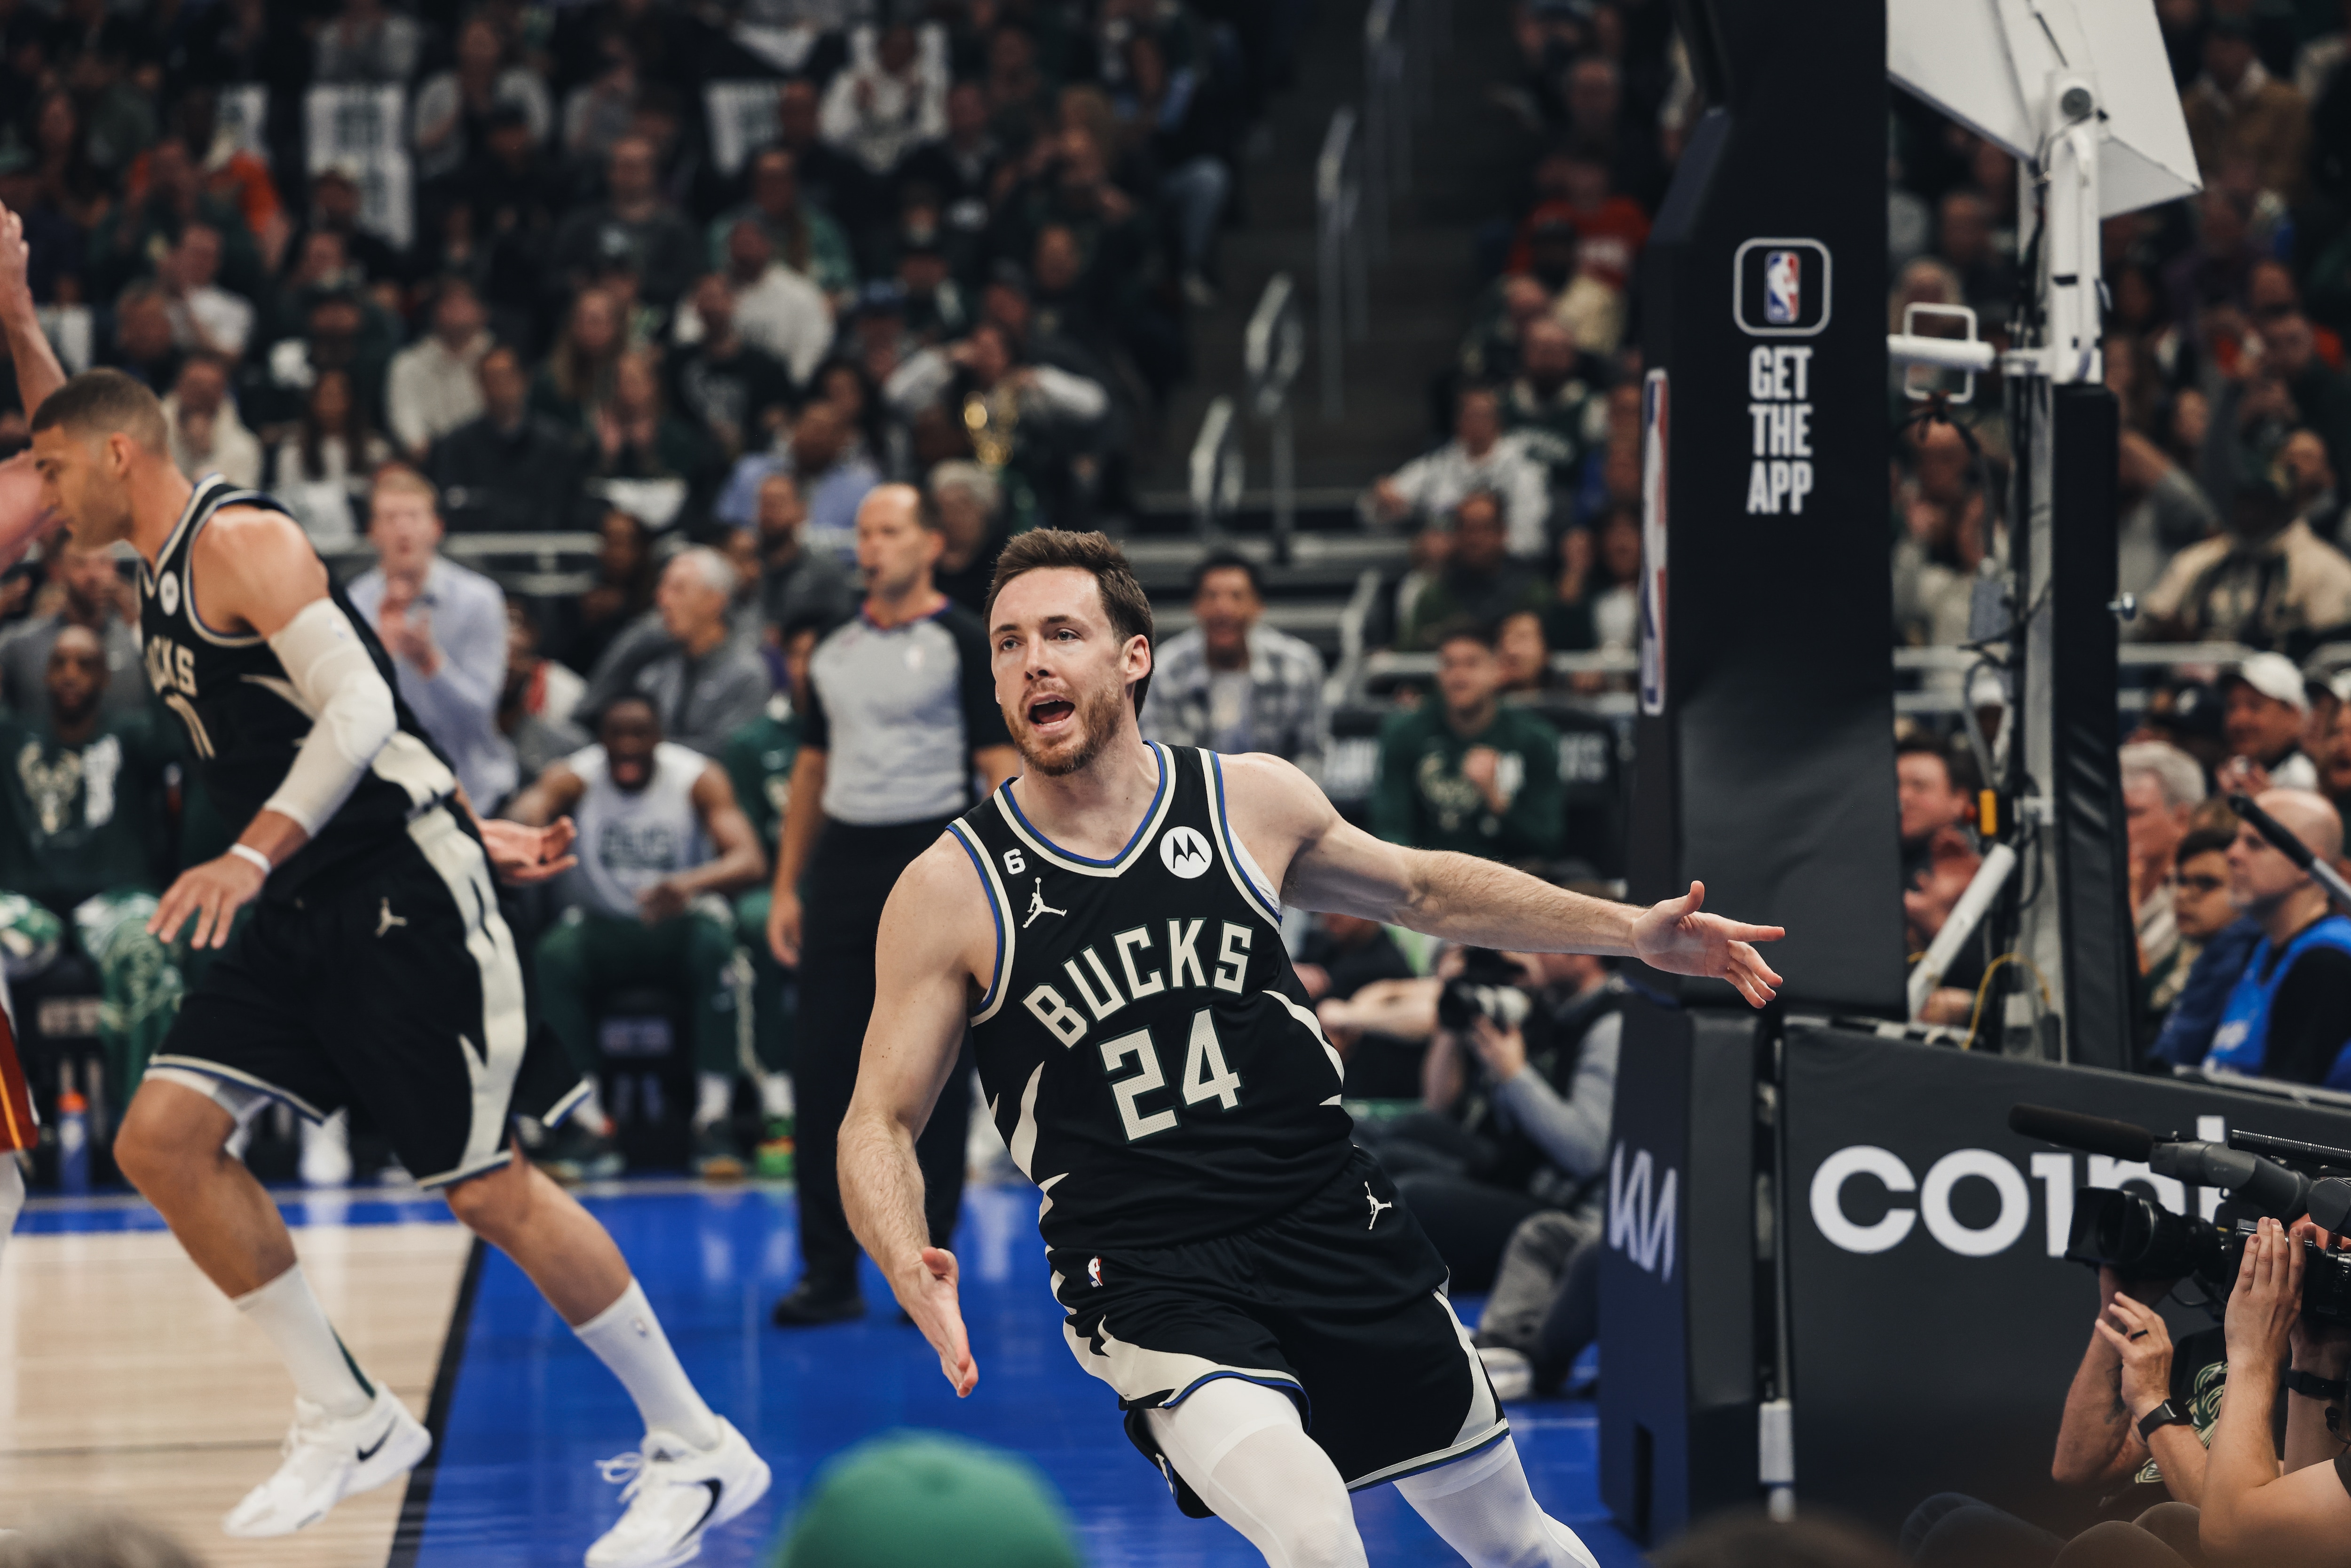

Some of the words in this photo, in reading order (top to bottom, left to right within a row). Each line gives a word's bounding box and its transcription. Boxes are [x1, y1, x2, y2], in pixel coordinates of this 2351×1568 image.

[1749, 346, 1813, 400] GET
[1748, 403, 1813, 457] THE
[1746, 460, 1814, 515] APP
[1003, 848, 1026, 875] 6
[1020, 917, 1254, 1050] BUCKS
[1096, 1005, 1242, 1143] 24
